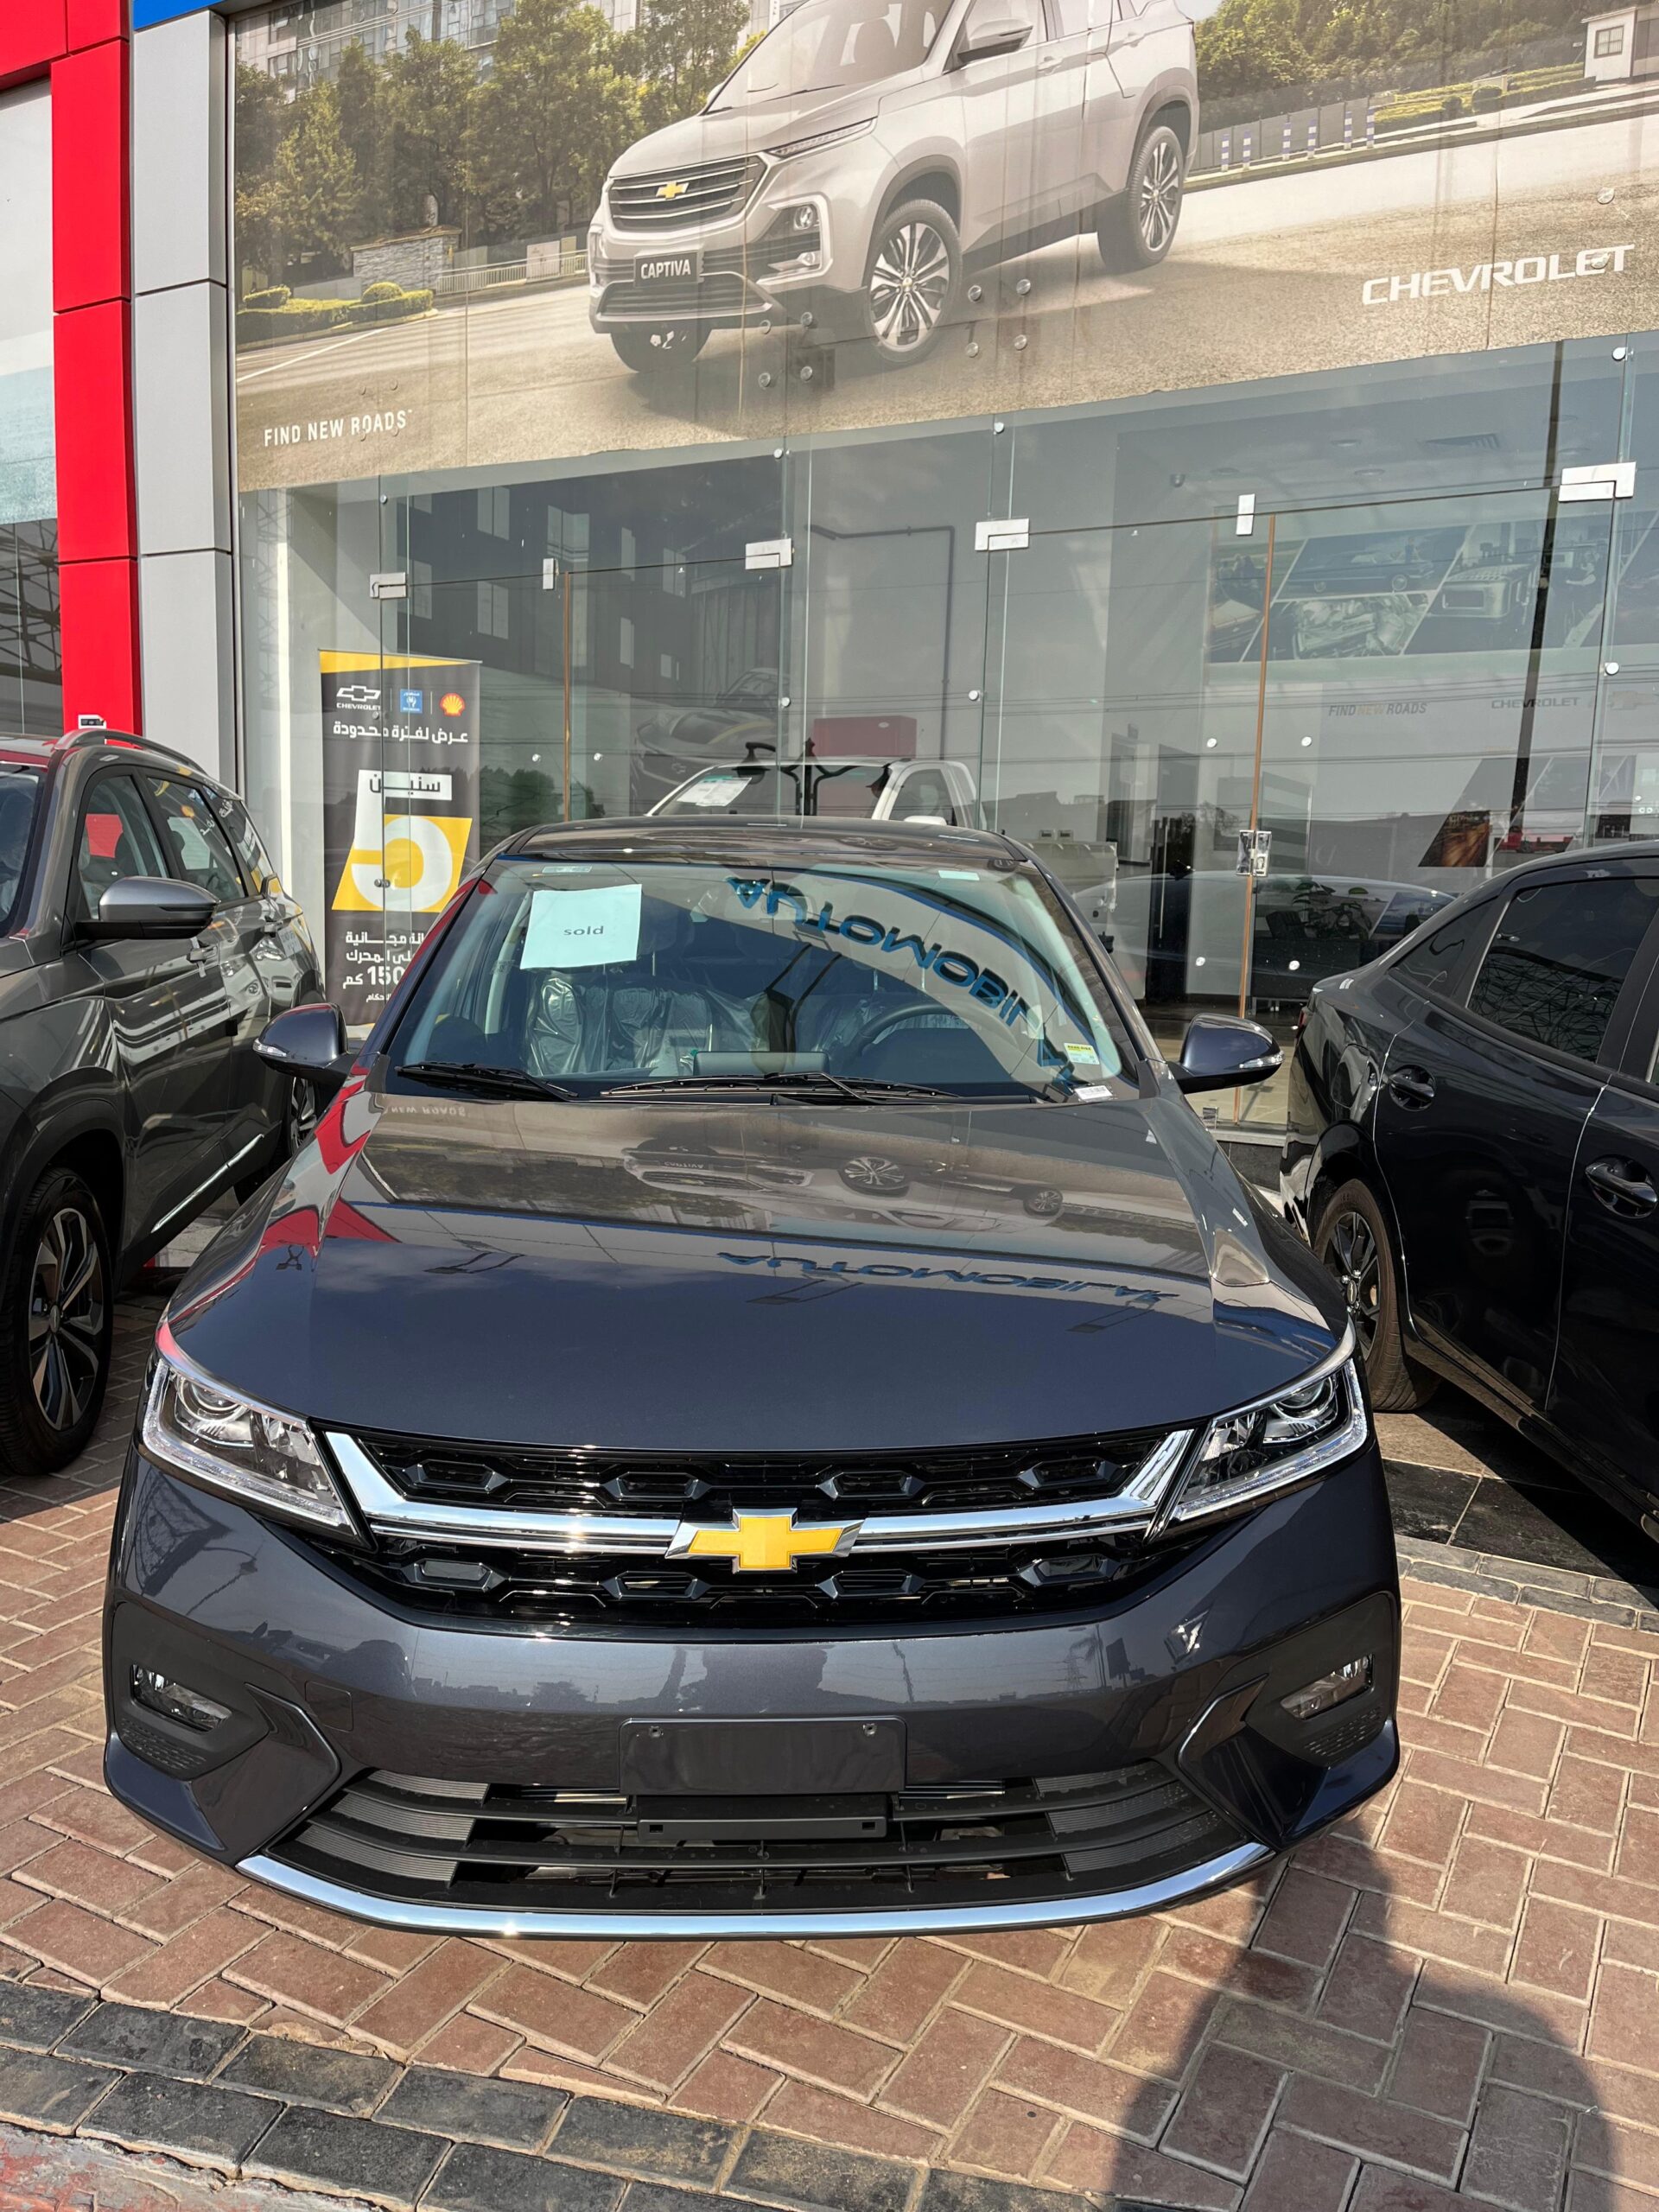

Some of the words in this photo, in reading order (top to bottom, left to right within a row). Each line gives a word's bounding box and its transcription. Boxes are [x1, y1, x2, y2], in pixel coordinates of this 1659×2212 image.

[641, 259, 691, 279] CAPTIVA
[1362, 244, 1636, 305] CHEVROLET
[264, 424, 301, 447] FIND
[308, 418, 345, 442] NEW
[351, 410, 407, 435] ROADS
[1329, 704, 1357, 716] FIND
[1386, 702, 1427, 715] ROADS
[1491, 696, 1580, 709] CHEVROLET
[333, 721, 390, 739] محدودة
[391, 725, 429, 741] لفترة
[432, 728, 469, 745] عرض
[369, 773, 442, 796] سنين
[351, 769, 453, 912] 5
[563, 925, 604, 936] sold
[342, 973, 364, 989] كم
